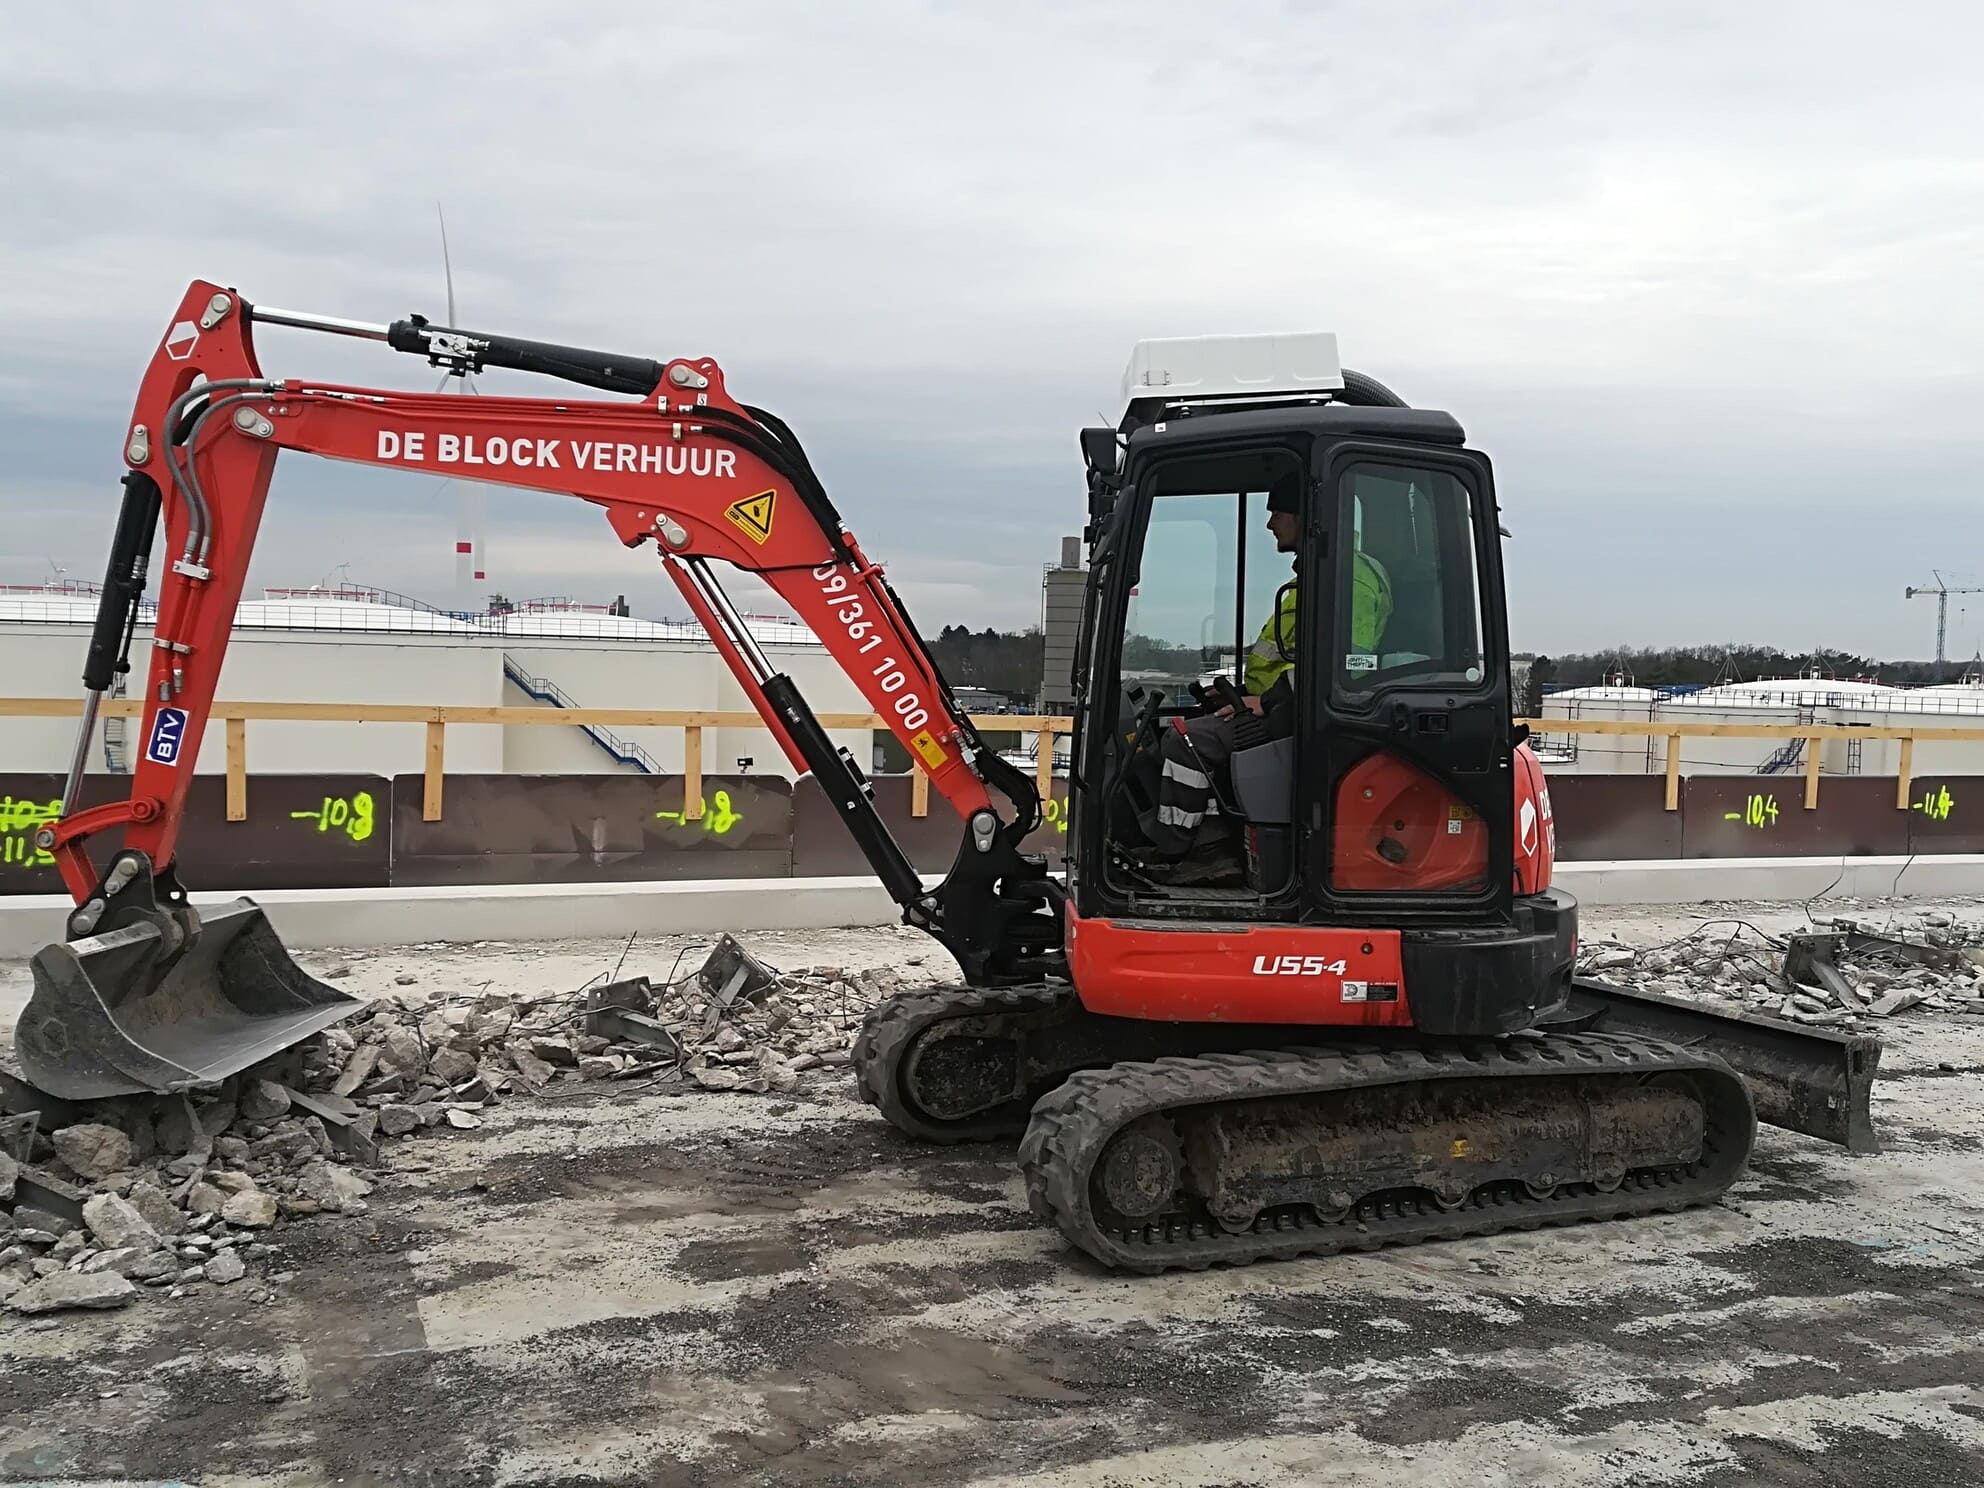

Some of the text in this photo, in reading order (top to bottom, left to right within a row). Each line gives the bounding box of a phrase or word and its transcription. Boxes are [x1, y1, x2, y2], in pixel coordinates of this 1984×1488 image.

[377, 430, 737, 478] DE BLOCK VERHUUR
[811, 559, 929, 731] 09/361 10 00
[156, 712, 180, 758] BTV
[1252, 955, 1347, 976] U55-4
